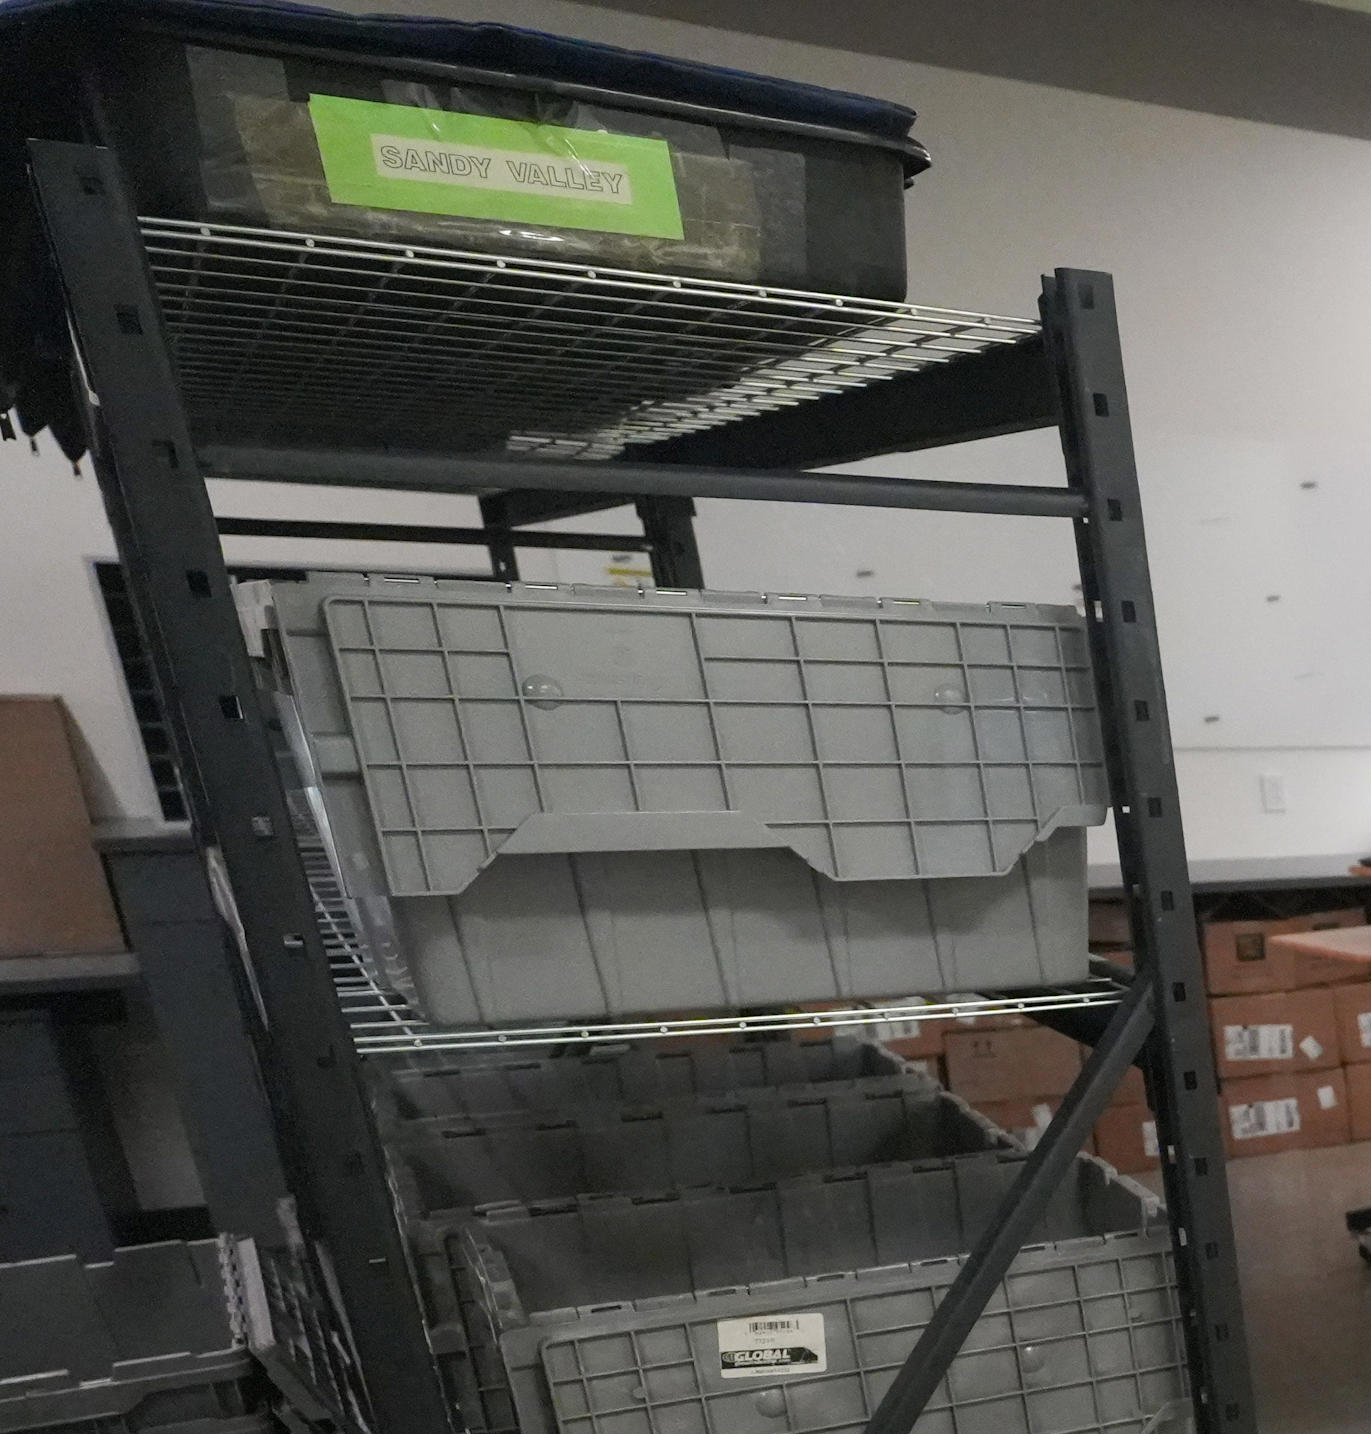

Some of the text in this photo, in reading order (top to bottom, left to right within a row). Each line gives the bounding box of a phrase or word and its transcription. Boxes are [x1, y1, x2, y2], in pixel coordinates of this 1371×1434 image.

[380, 145, 622, 194] SANDY VALLEY
[734, 1348, 791, 1362] GLOBAL
